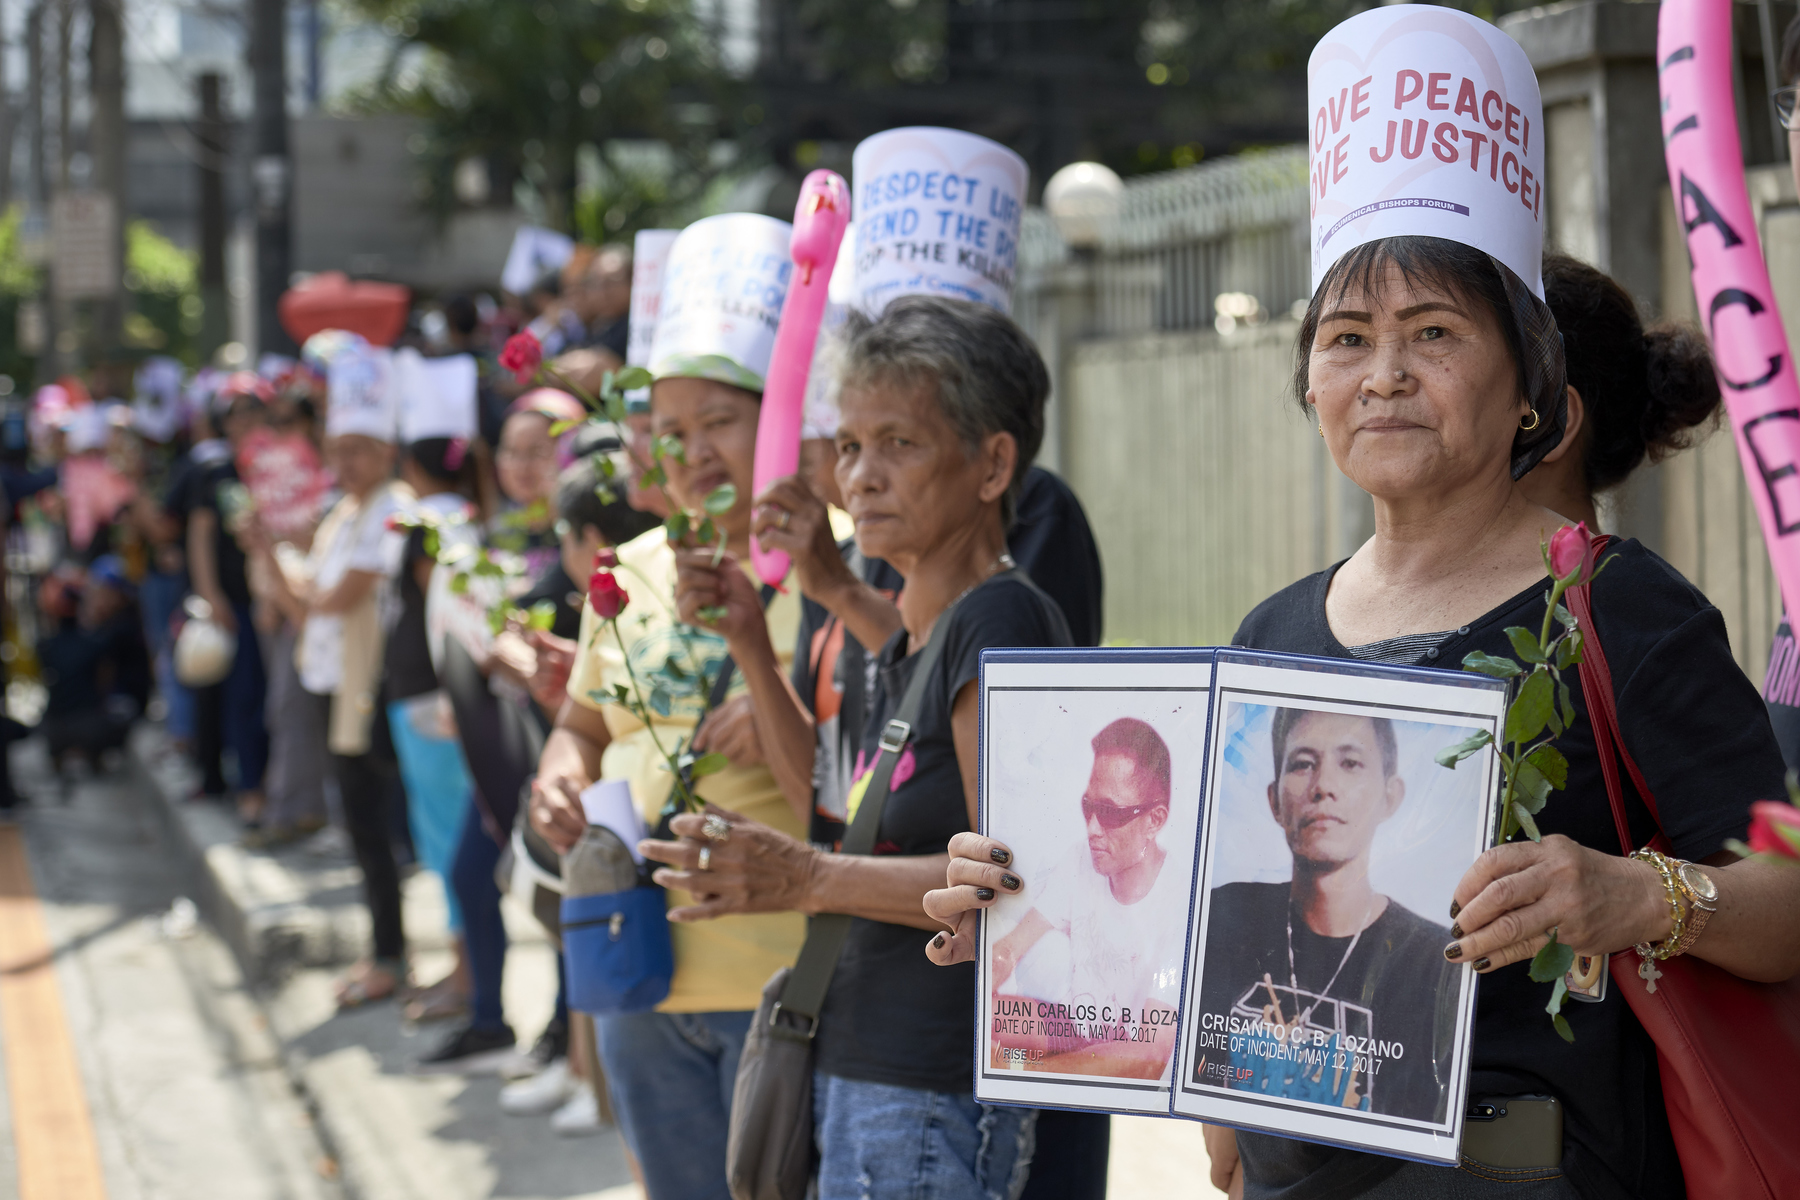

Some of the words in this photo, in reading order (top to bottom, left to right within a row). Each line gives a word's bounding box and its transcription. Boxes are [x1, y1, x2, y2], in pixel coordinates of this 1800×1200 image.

[1394, 69, 1530, 157] PEACE!
[1311, 134, 1351, 220] OVE
[1369, 118, 1541, 223] JUSTICE!
[936, 211, 989, 249] THE
[1331, 205, 1377, 235] ECUMENICAL
[1378, 199, 1420, 210] BISHOPS
[1422, 199, 1456, 211] FORUM
[895, 241, 947, 263] THE
[994, 1000, 1032, 1018] JUAN
[1037, 1002, 1097, 1021] CARLOS
[1101, 1007, 1116, 1022] C.
[1121, 1008, 1136, 1024] B.
[994, 1018, 1019, 1035] DATE
[1021, 1020, 1035, 1036] OF
[1037, 1021, 1086, 1039] INCIDENT:
[1089, 1025, 1110, 1041] MAY
[1112, 1026, 1128, 1043] 12,
[1131, 1027, 1157, 1044] 2017
[1201, 1012, 1285, 1041] CRISANTO
[1291, 1027, 1306, 1045] C.
[1313, 1030, 1328, 1048] B.
[1335, 1033, 1404, 1060] LOZANO
[1003, 1047, 1027, 1060] RISE
[1030, 1049, 1044, 1061] UP
[1200, 1031, 1228, 1051] DATE
[1230, 1036, 1244, 1053] OF
[1247, 1039, 1302, 1063] INCIDENT:
[1304, 1048, 1329, 1067] MAY
[1332, 1053, 1349, 1072] 12,
[1352, 1055, 1382, 1075] 2017
[1207, 1062, 1235, 1077] RISE
[1236, 1067, 1254, 1081] UP
